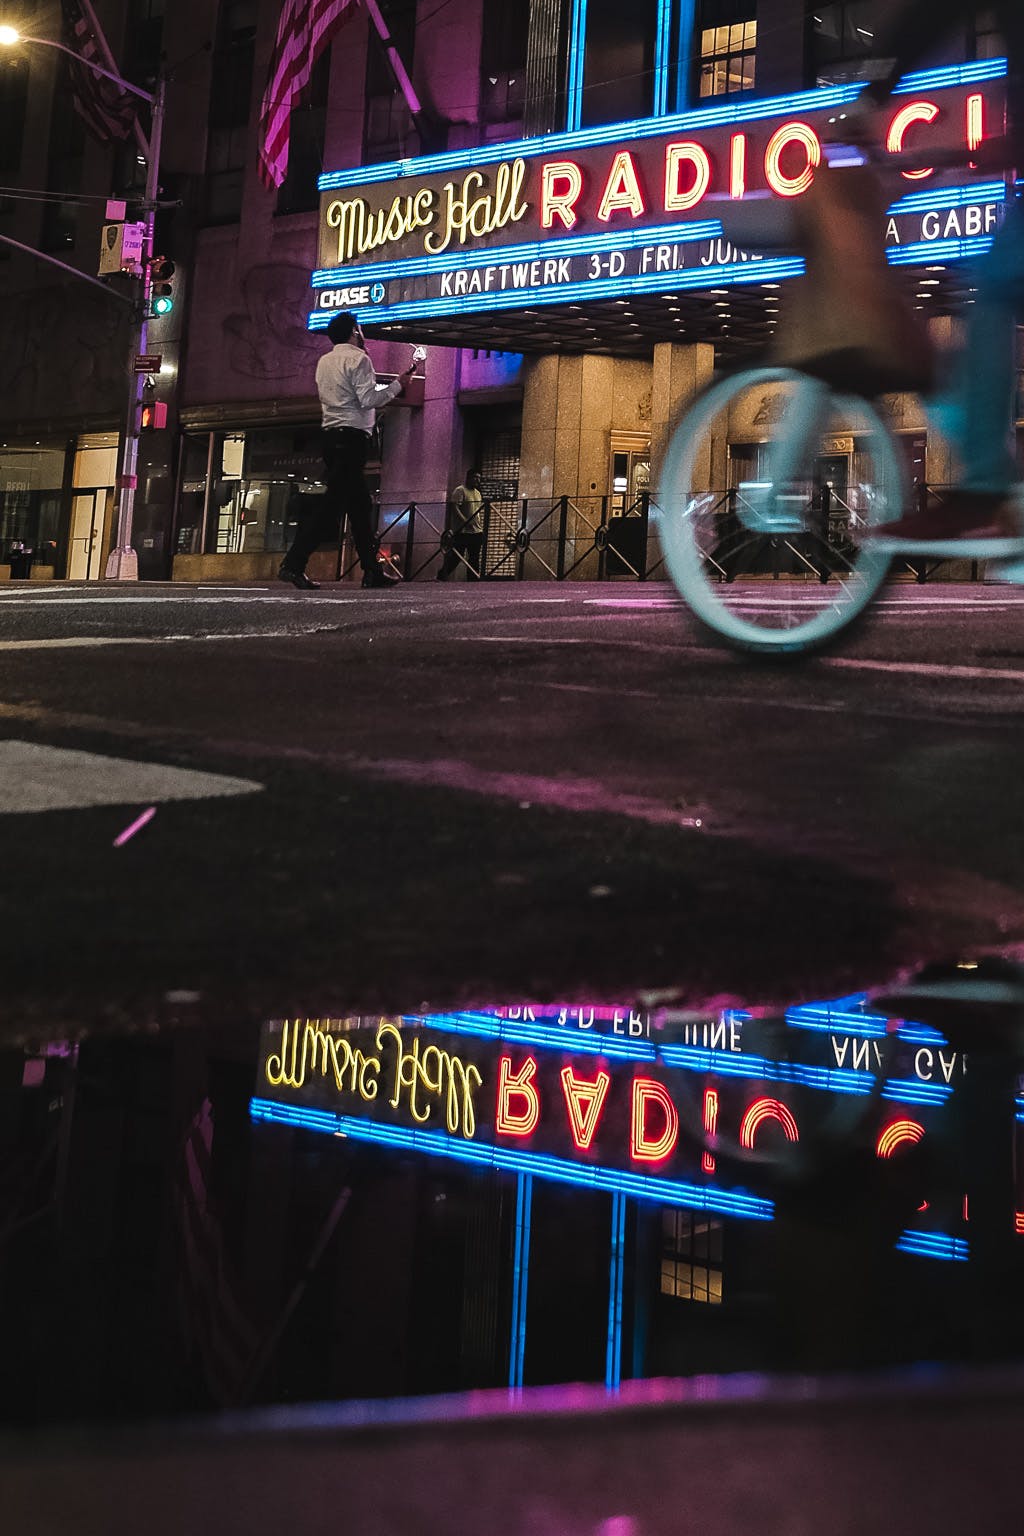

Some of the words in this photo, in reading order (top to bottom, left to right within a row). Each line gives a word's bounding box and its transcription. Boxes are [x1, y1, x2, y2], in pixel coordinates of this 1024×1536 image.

[424, 158, 529, 254] Hall
[540, 122, 821, 229] RADIO
[319, 286, 369, 308] CHASE
[440, 259, 571, 296] KRAFTWERK
[589, 252, 625, 280] 3-D
